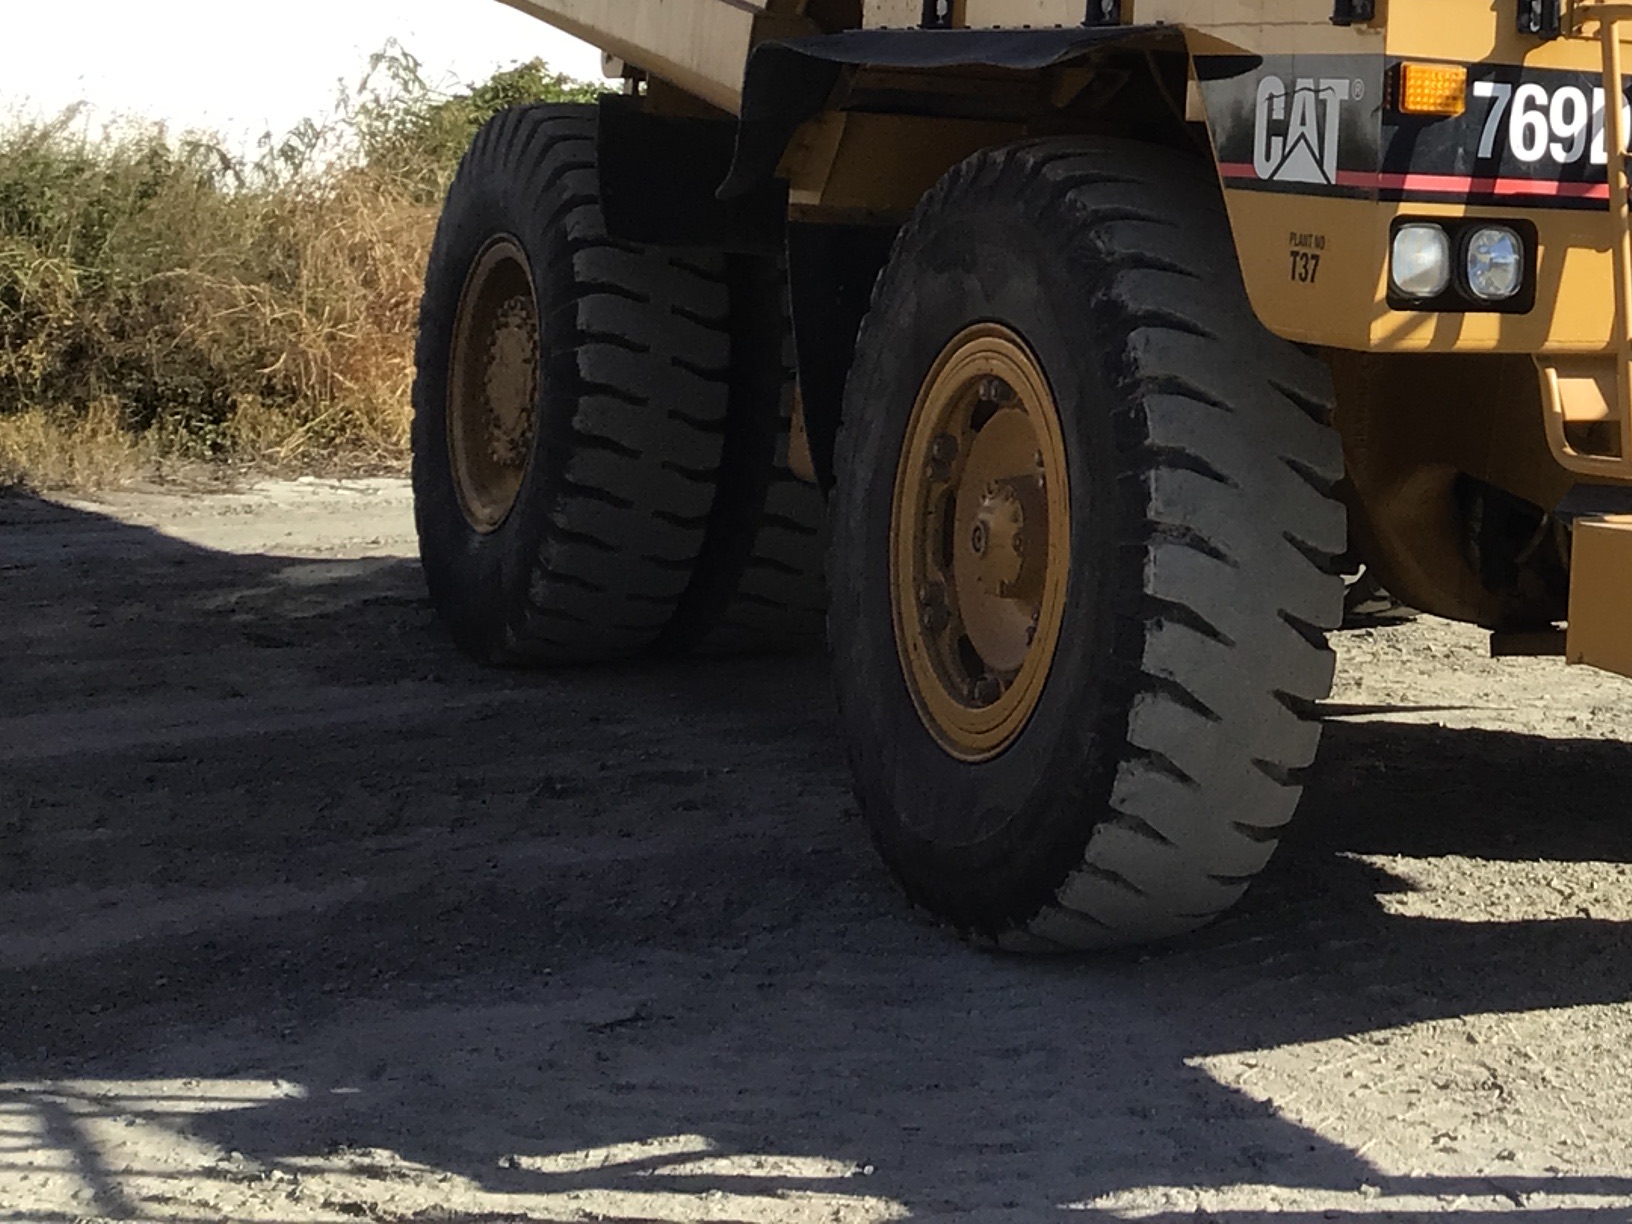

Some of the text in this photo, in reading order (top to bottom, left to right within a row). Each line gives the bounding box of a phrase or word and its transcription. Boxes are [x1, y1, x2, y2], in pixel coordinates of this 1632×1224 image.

[1253, 75, 1350, 185] CAT
[1289, 231, 1313, 248] PLANT
[1289, 250, 1320, 284] T37
